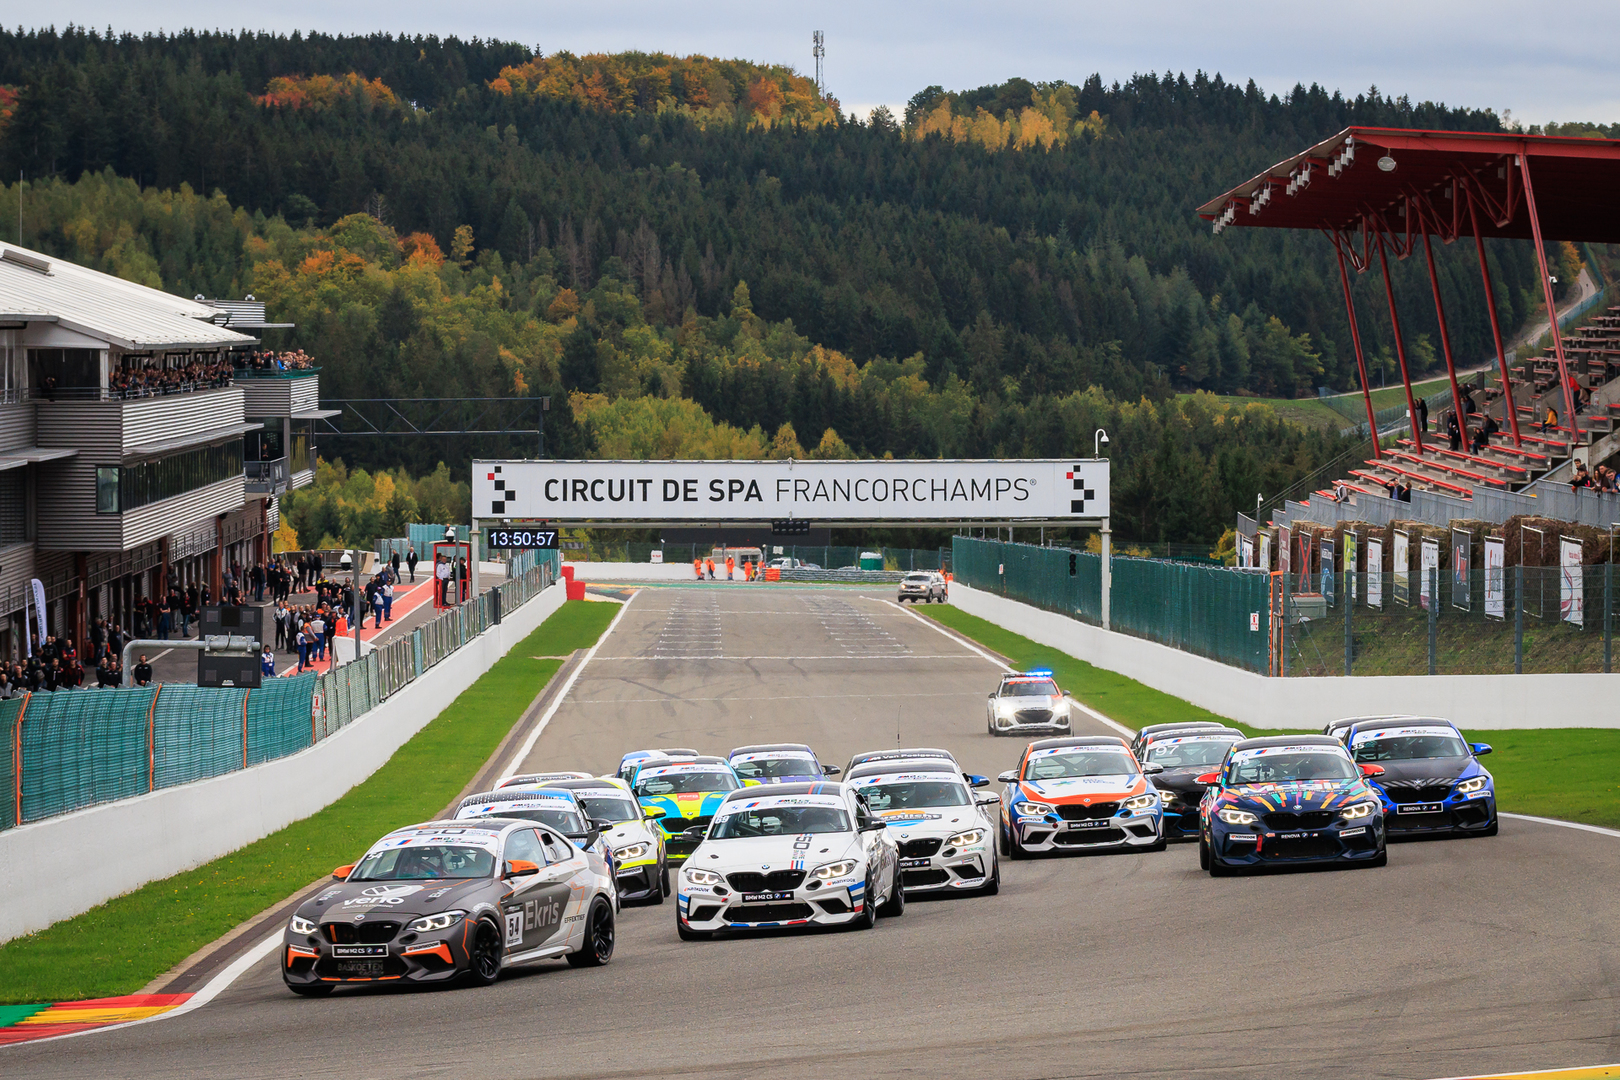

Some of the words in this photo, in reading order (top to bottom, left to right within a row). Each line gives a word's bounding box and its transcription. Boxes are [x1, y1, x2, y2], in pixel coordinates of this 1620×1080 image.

[544, 479, 653, 502] CIRCUIT
[663, 479, 697, 501] DE
[708, 478, 763, 502] SPA
[490, 531, 555, 546] 13:50:57
[1155, 745, 1179, 756] 97
[524, 896, 560, 931] Ekris
[509, 916, 519, 937] 54
